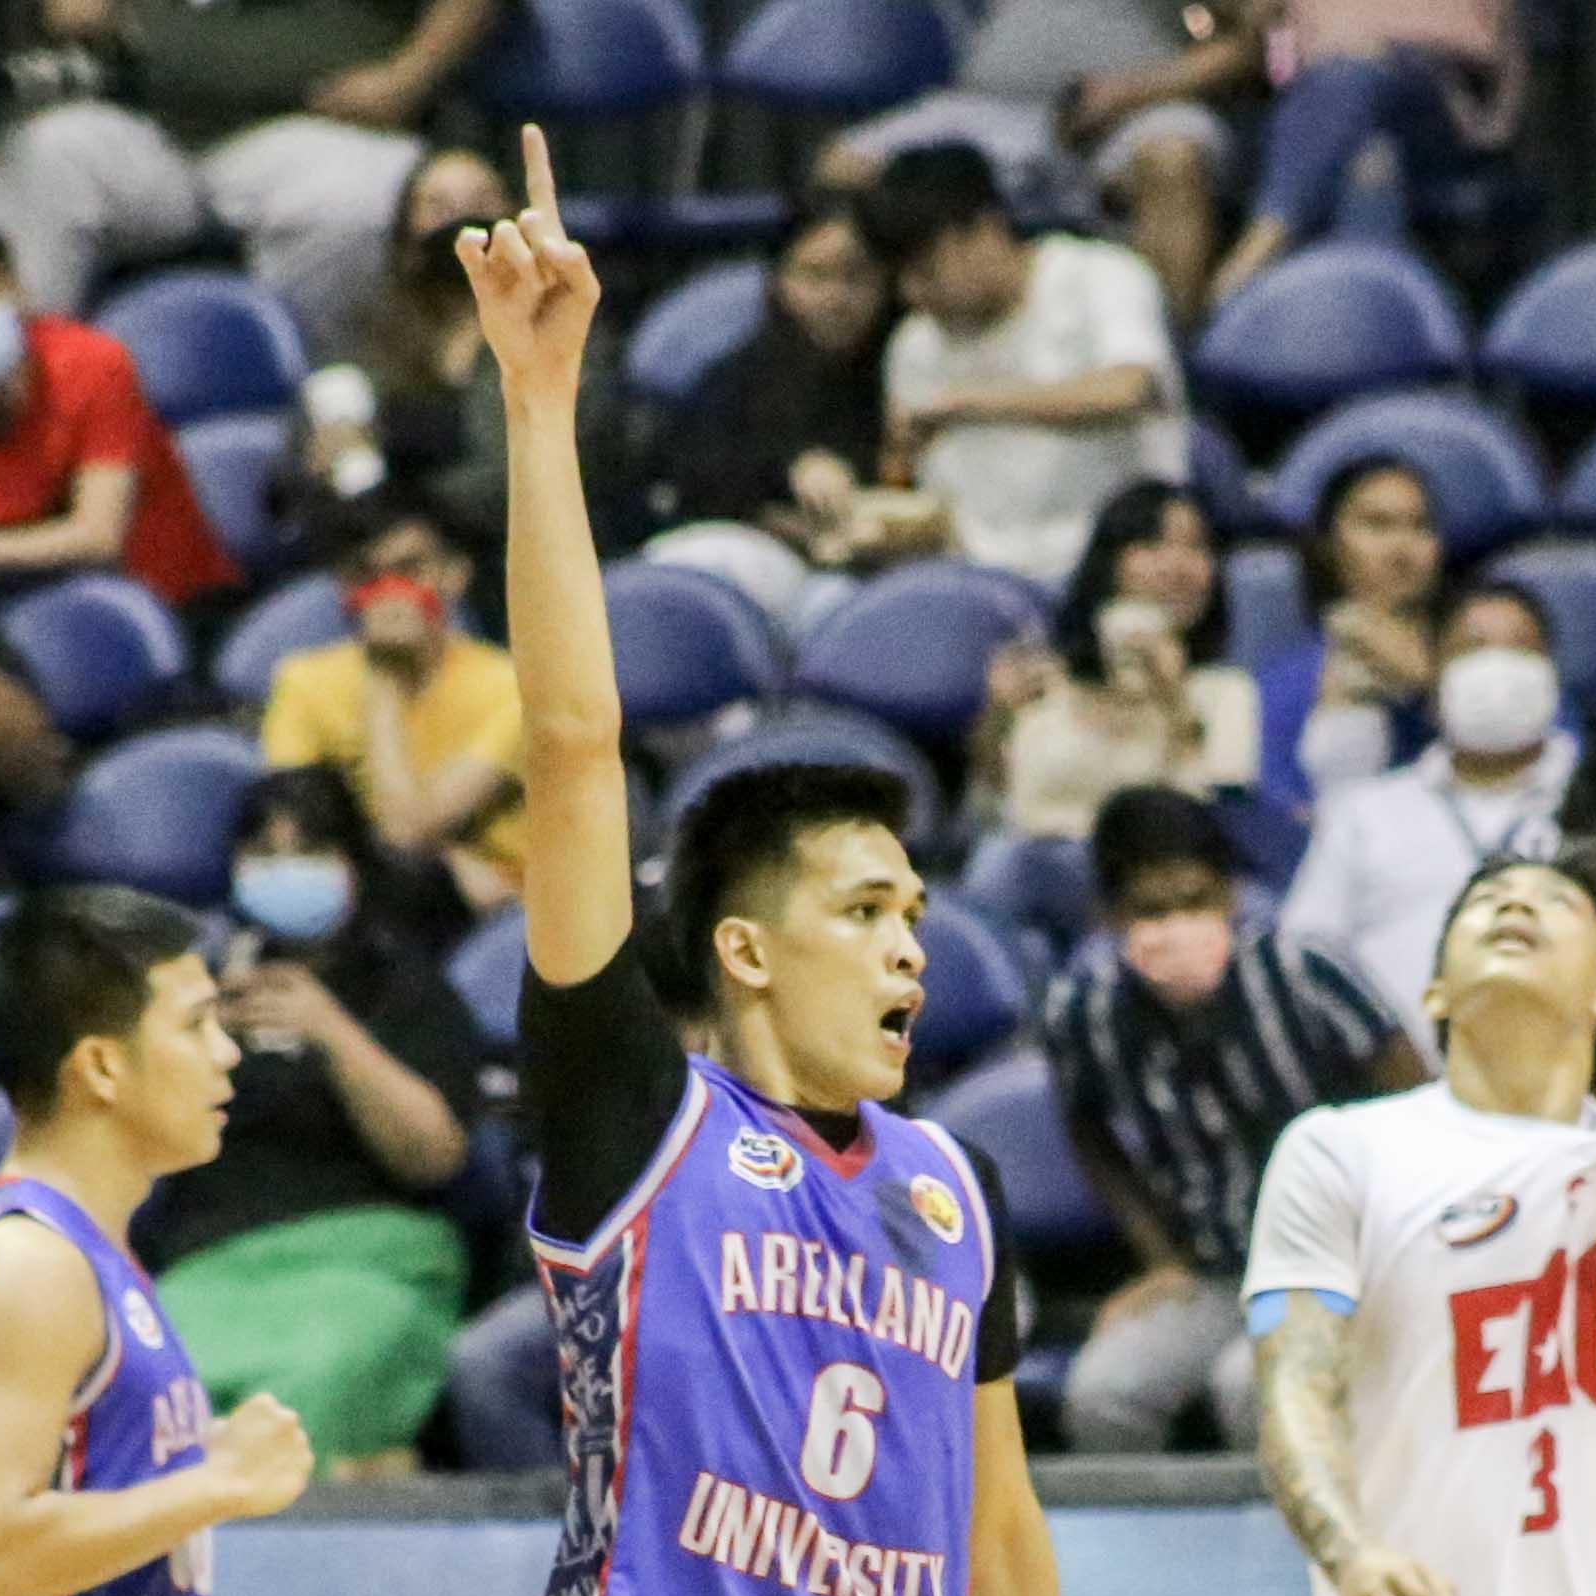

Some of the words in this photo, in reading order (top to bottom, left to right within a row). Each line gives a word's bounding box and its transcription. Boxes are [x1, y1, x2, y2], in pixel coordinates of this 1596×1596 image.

[720, 1231, 974, 1380] ARELLANO
[801, 1361, 885, 1501] 6
[1520, 1427, 1560, 1536] 3
